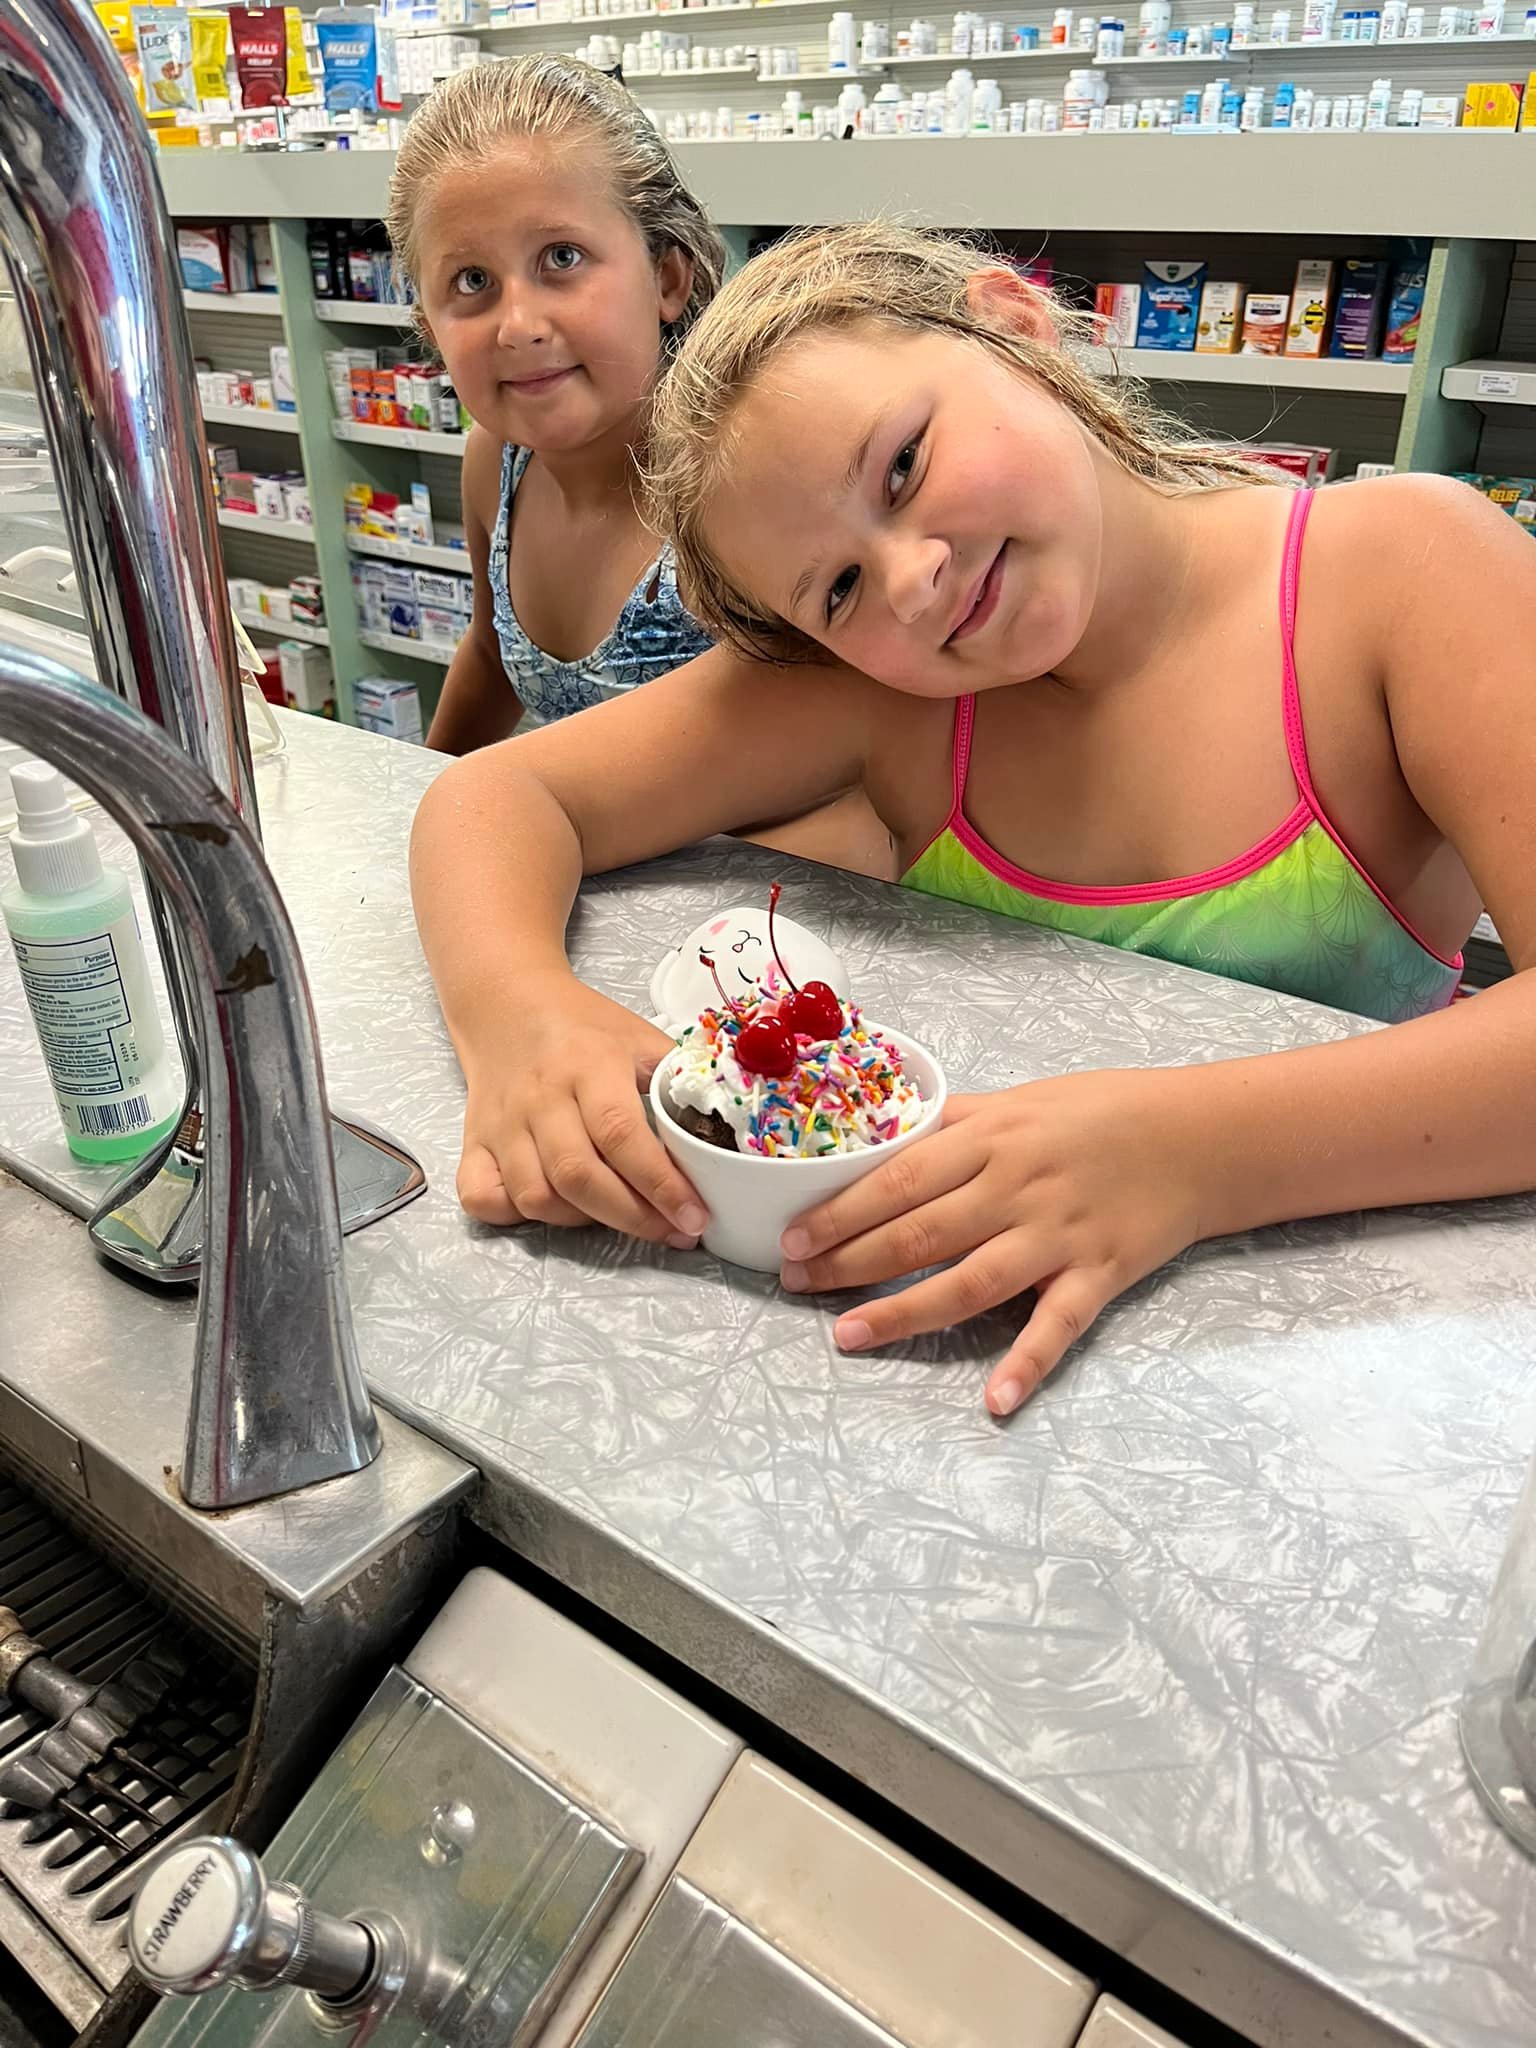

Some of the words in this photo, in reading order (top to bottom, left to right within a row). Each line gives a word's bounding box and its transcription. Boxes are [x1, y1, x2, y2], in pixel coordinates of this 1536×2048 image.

[240, 42, 279, 56] HALLS
[326, 42, 367, 56] HALLS
[84, 952, 110, 964] Purpose
[144, 1855, 218, 1963] STRAWBERRY
